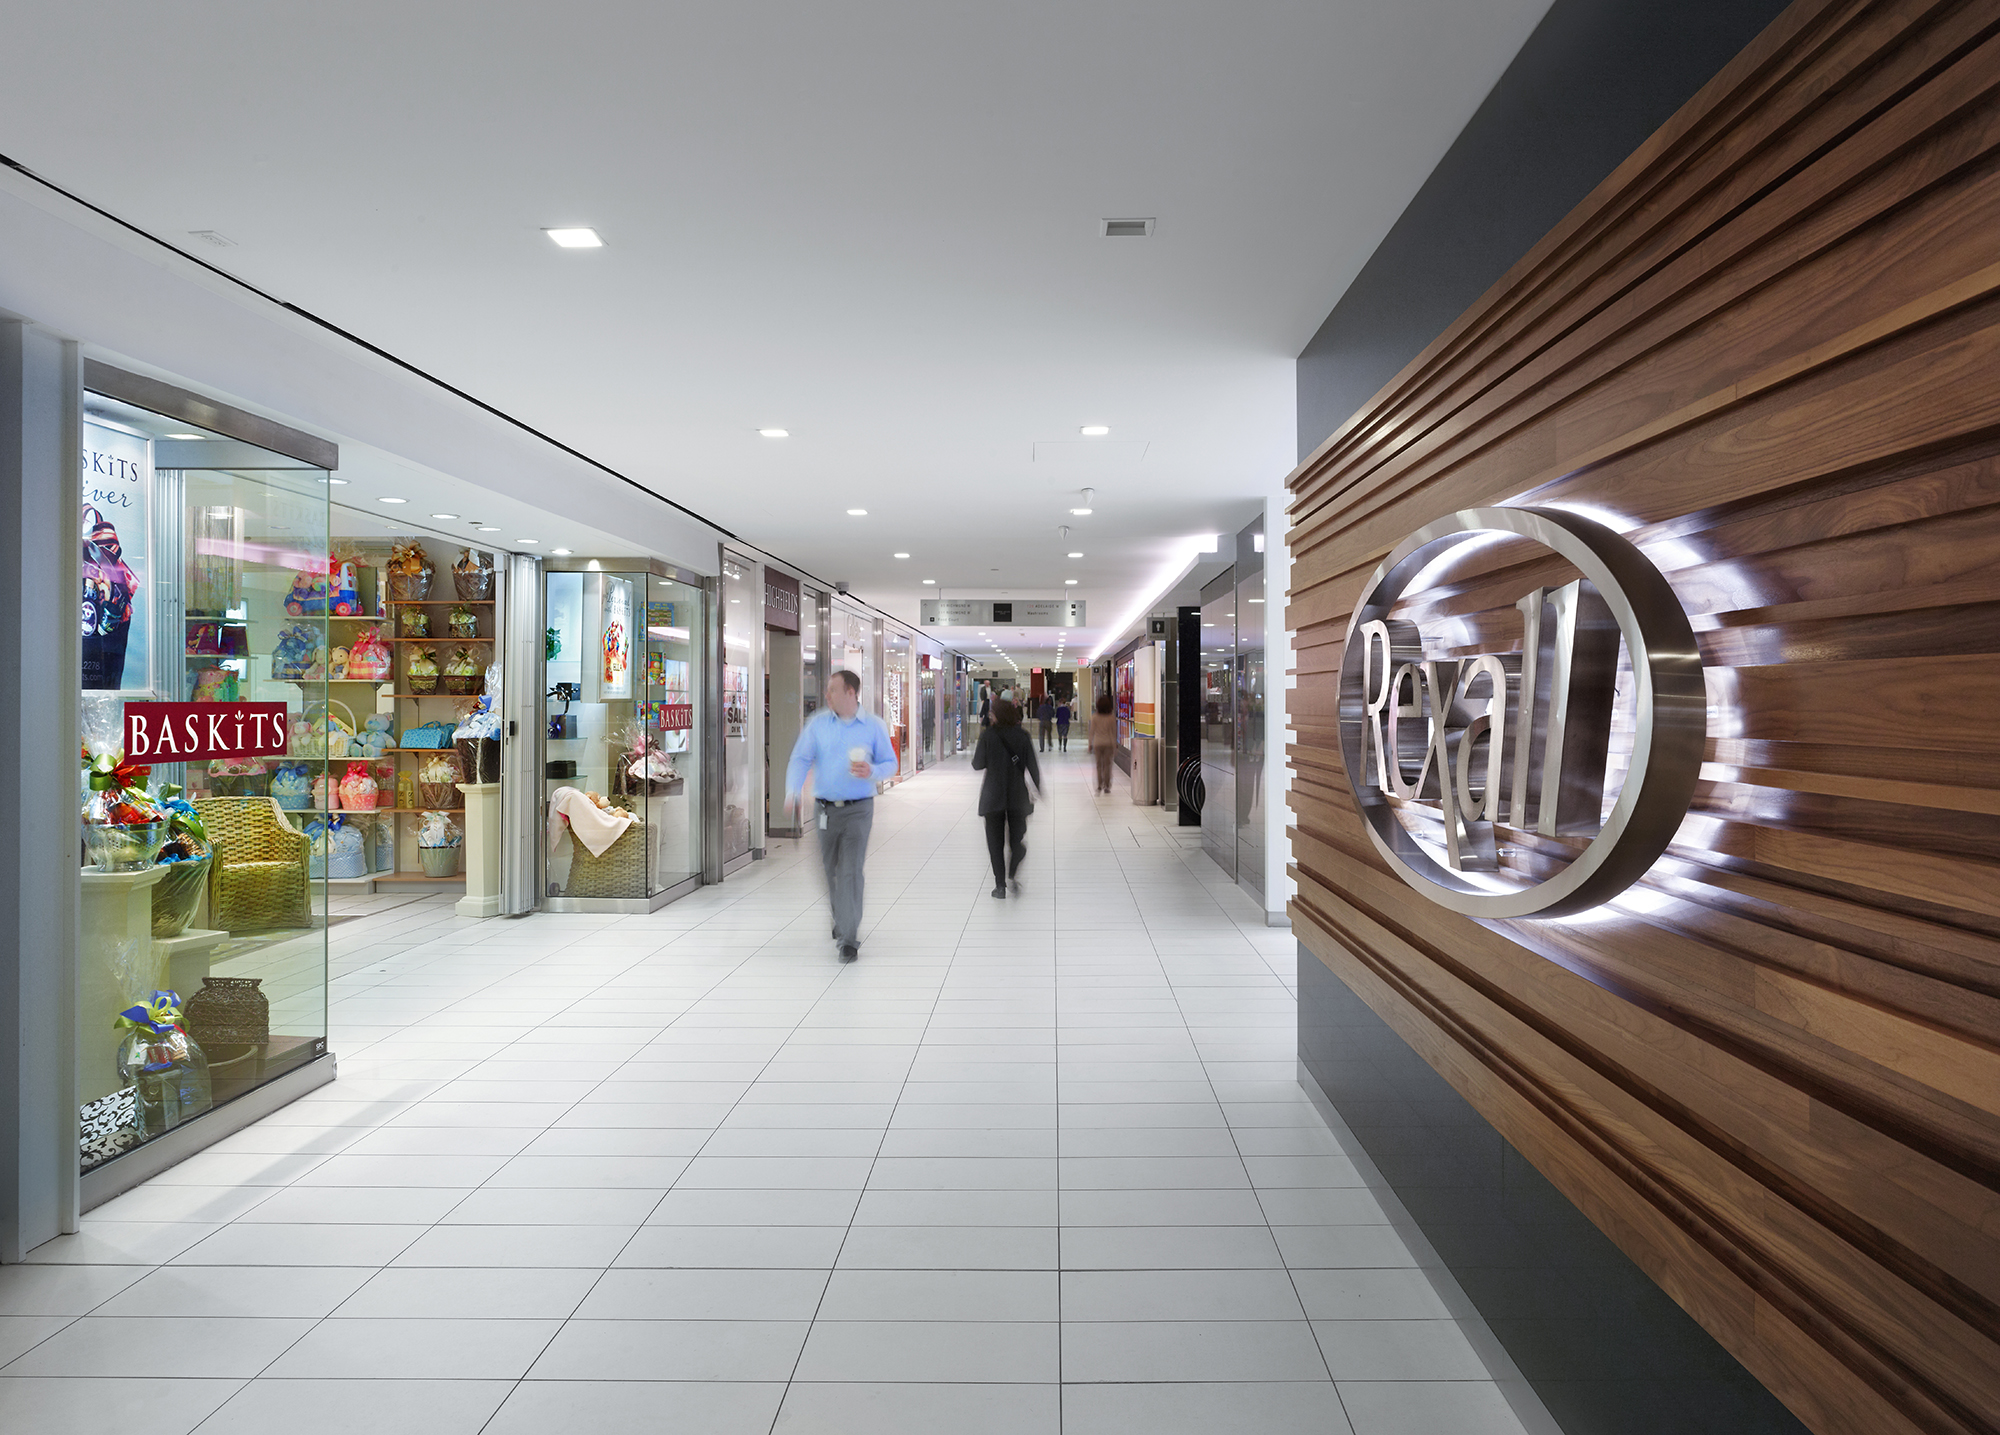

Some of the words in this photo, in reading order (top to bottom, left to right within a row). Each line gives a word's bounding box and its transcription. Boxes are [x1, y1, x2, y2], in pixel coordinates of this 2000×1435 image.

[764, 582, 799, 615] HIGHFIELDS
[727, 706, 747, 724] SALE
[1359, 578, 1592, 873] Rexall
